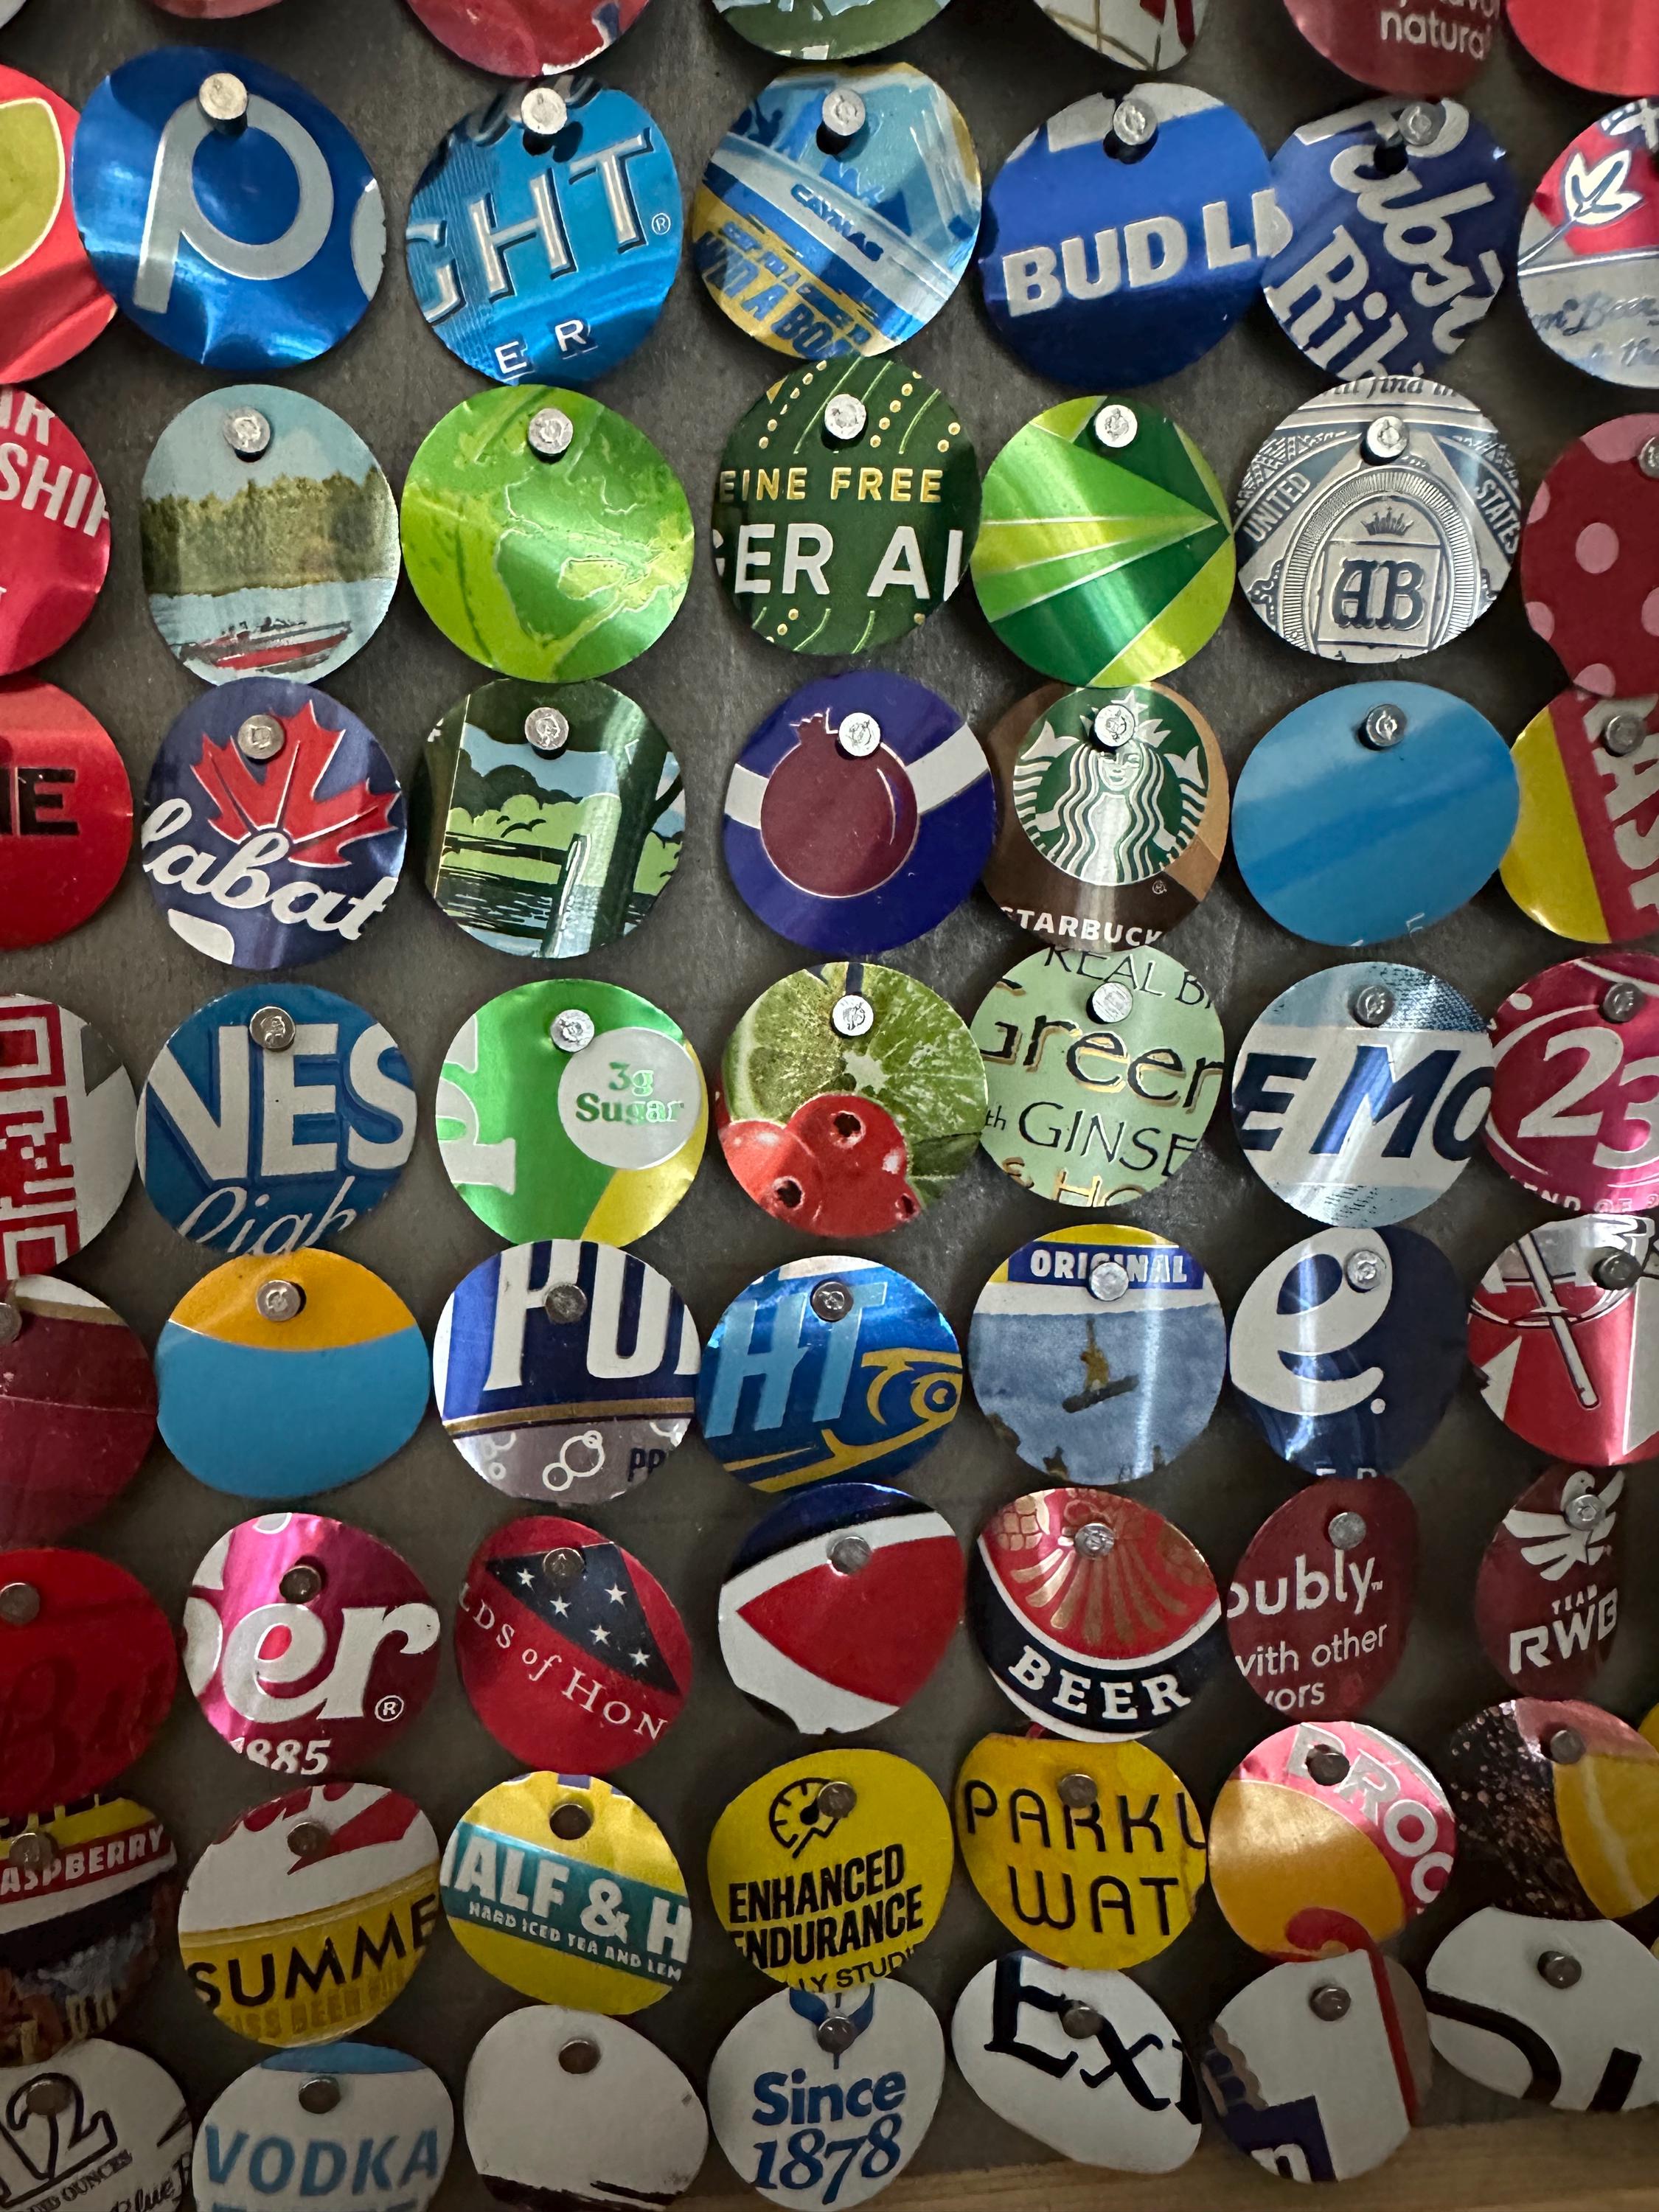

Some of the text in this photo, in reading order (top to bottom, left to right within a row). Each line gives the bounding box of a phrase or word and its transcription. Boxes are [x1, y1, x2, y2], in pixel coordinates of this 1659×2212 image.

[134, 94, 386, 314] p
[718, 467, 943, 504] EINE FREE
[1242, 470, 1521, 554] UNITED STATES
[1332, 557, 1427, 632] AB
[0, 767, 80, 836] E
[1001, 906, 1164, 947] TARBUCK
[1175, 970, 1212, 1009] B
[575, 1092, 686, 1126] Sugar
[608, 1061, 655, 1097] 3g
[1517, 1026, 1659, 1170] 23
[1007, 1644, 1192, 1720] BEER
[1311, 1624, 1388, 1669] other
[521, 1648, 563, 1682] of
[560, 1666, 668, 1740] HON
[230, 1737, 333, 1775] 885
[580, 1877, 630, 1944] &
[728, 1843, 905, 1924] ENHANCED
[1006, 1864, 1180, 1937] WAT
[187, 1892, 437, 2010] SUMME
[468, 1900, 517, 1928] HARD
[521, 1917, 562, 1943] ICED
[567, 1932, 598, 1955] TEA
[604, 1944, 642, 1969] AND
[751, 2068, 907, 2126] Since
[205, 2124, 439, 2198] VODKA
[751, 2112, 904, 2205] 1878
